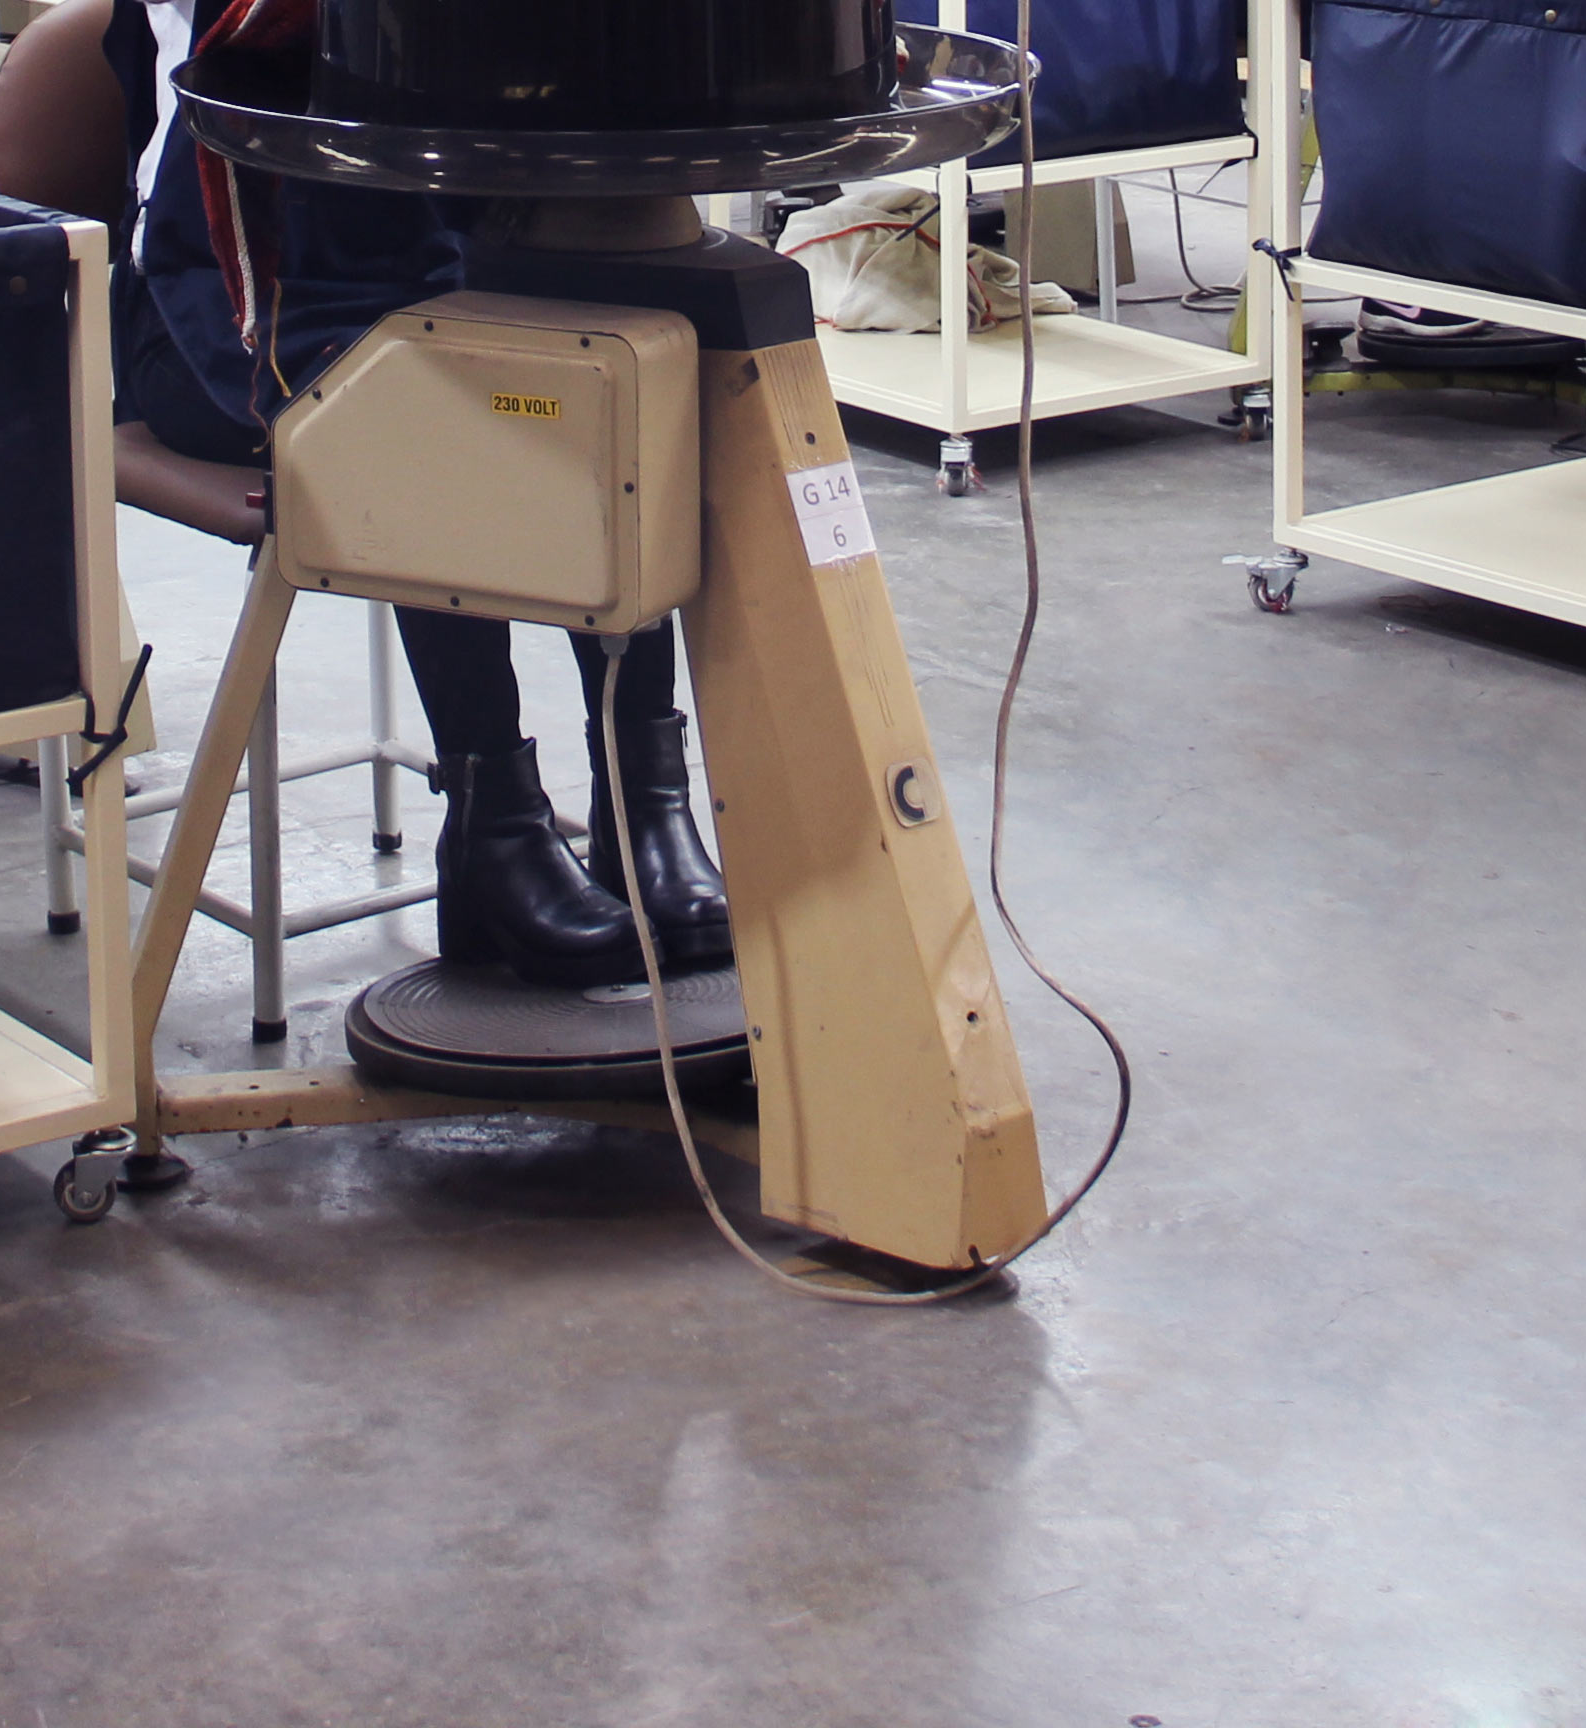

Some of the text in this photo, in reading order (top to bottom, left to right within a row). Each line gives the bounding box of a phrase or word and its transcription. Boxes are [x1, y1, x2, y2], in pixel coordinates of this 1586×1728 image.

[494, 395, 558, 417] 230 VOLT
[802, 475, 851, 506] G 14
[833, 524, 847, 548] 6
